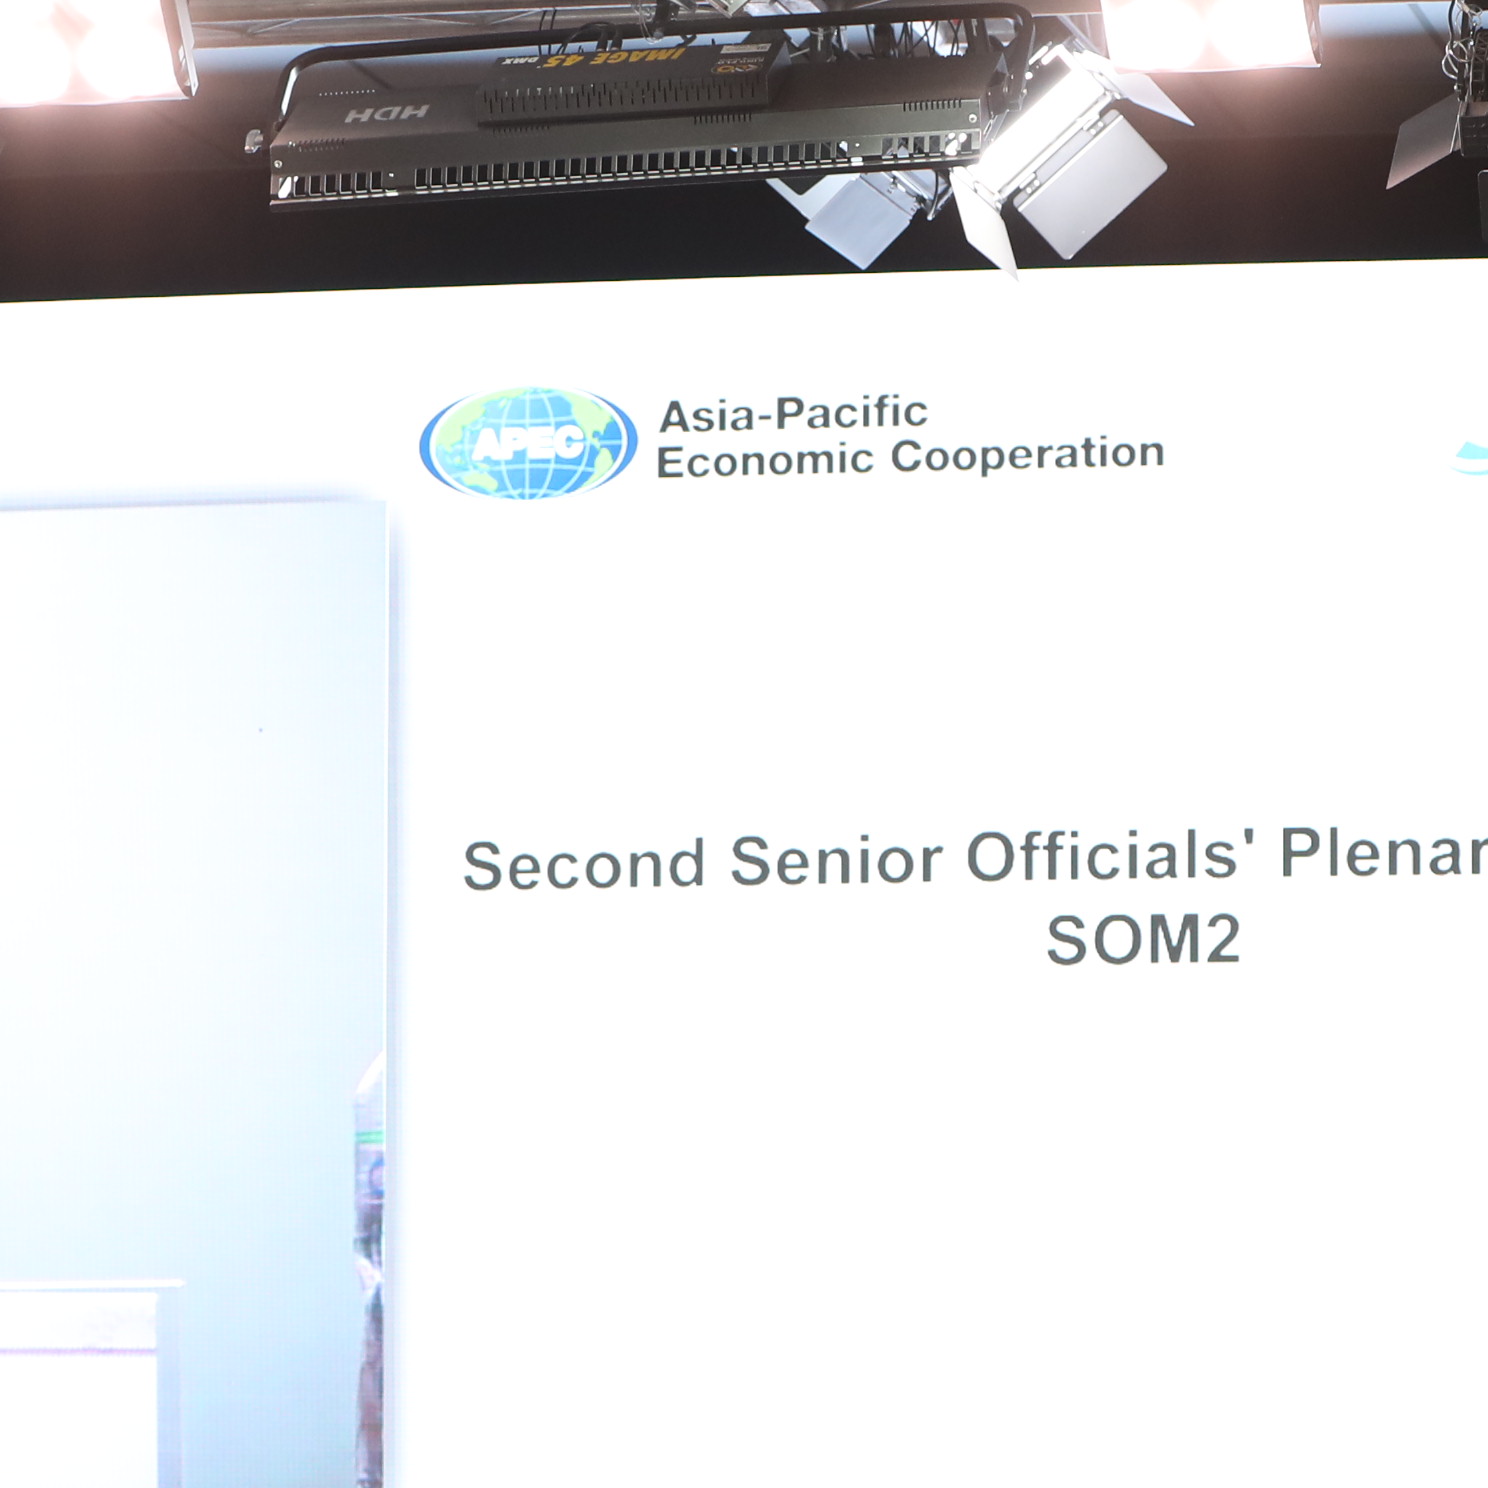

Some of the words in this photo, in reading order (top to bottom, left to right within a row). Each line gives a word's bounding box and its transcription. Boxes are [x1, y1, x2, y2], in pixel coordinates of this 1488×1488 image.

[500, 56, 540, 66] DMX
[590, 47, 687, 65] IMAGE
[344, 104, 430, 124] HDH
[659, 394, 928, 433] Asia-Pacific
[472, 425, 585, 461] APEC
[657, 441, 874, 479] Economic
[891, 435, 1164, 478] Cooperation
[464, 837, 704, 891] Second
[731, 834, 944, 886] Senior
[967, 827, 1254, 882] Officials'
[1047, 913, 1240, 966] SOM2
